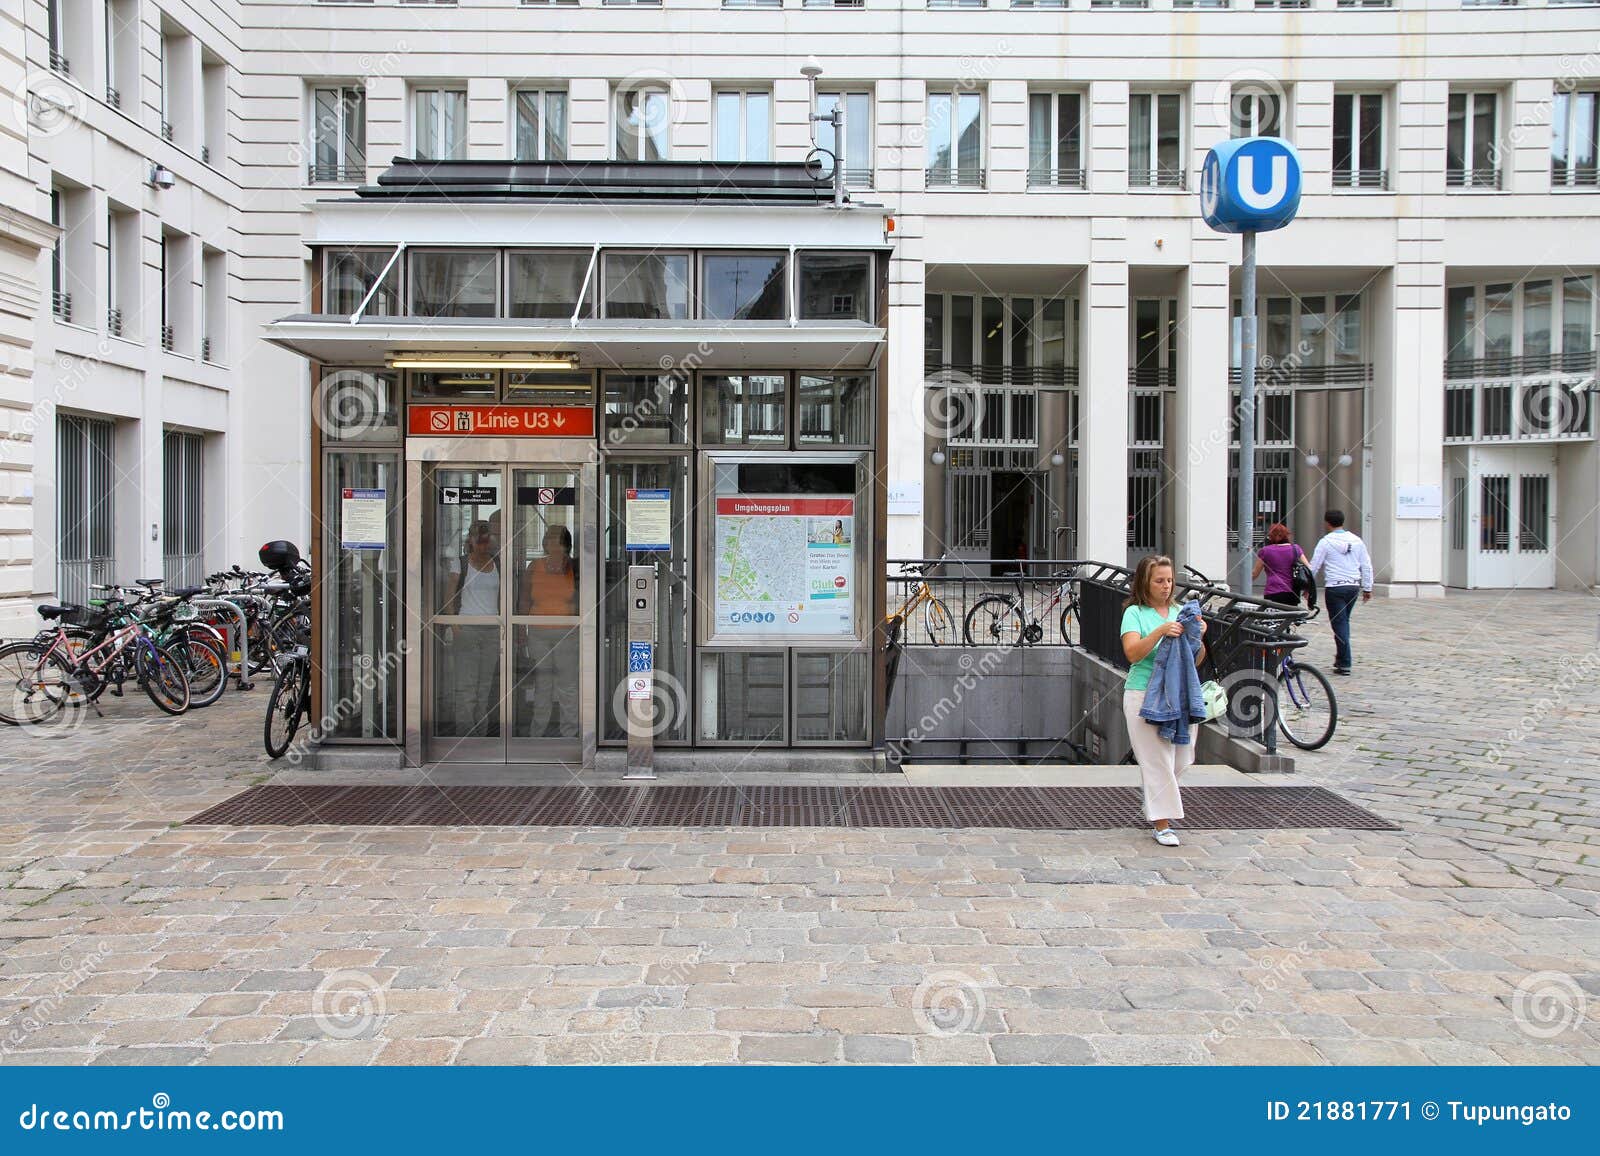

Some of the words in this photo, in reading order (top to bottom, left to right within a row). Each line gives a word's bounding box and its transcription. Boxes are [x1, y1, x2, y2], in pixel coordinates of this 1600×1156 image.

[1202, 161, 1218, 218] U
[1237, 156, 1288, 210] U
[477, 412, 519, 428] Linie
[524, 412, 549, 428] U3
[735, 503, 790, 513] Umgebungsplan
